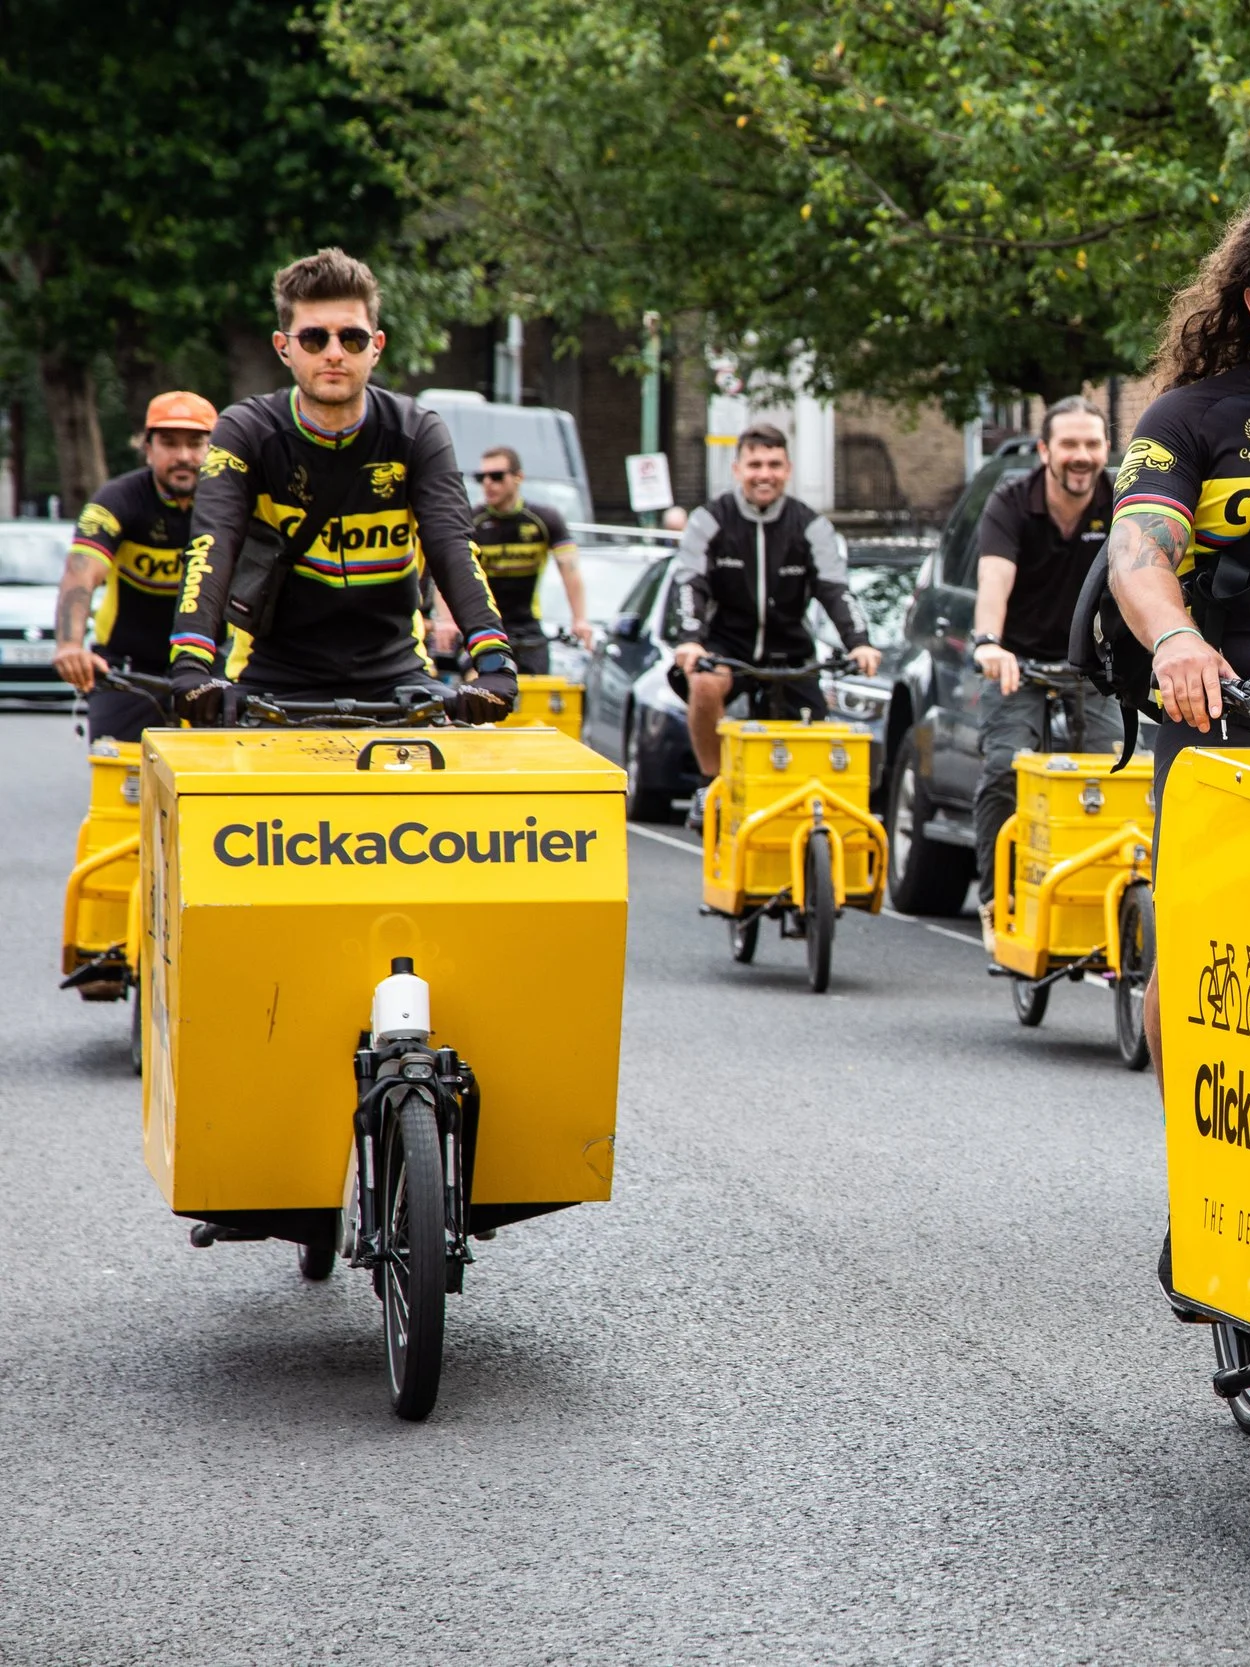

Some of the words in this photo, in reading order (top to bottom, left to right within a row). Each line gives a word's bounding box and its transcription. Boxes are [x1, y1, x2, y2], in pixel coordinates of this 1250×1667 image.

[279, 515, 410, 553] Clone
[179, 534, 215, 614] Cyclone
[213, 815, 597, 867] ClickaCourier
[1204, 1197, 1225, 1236] THE
